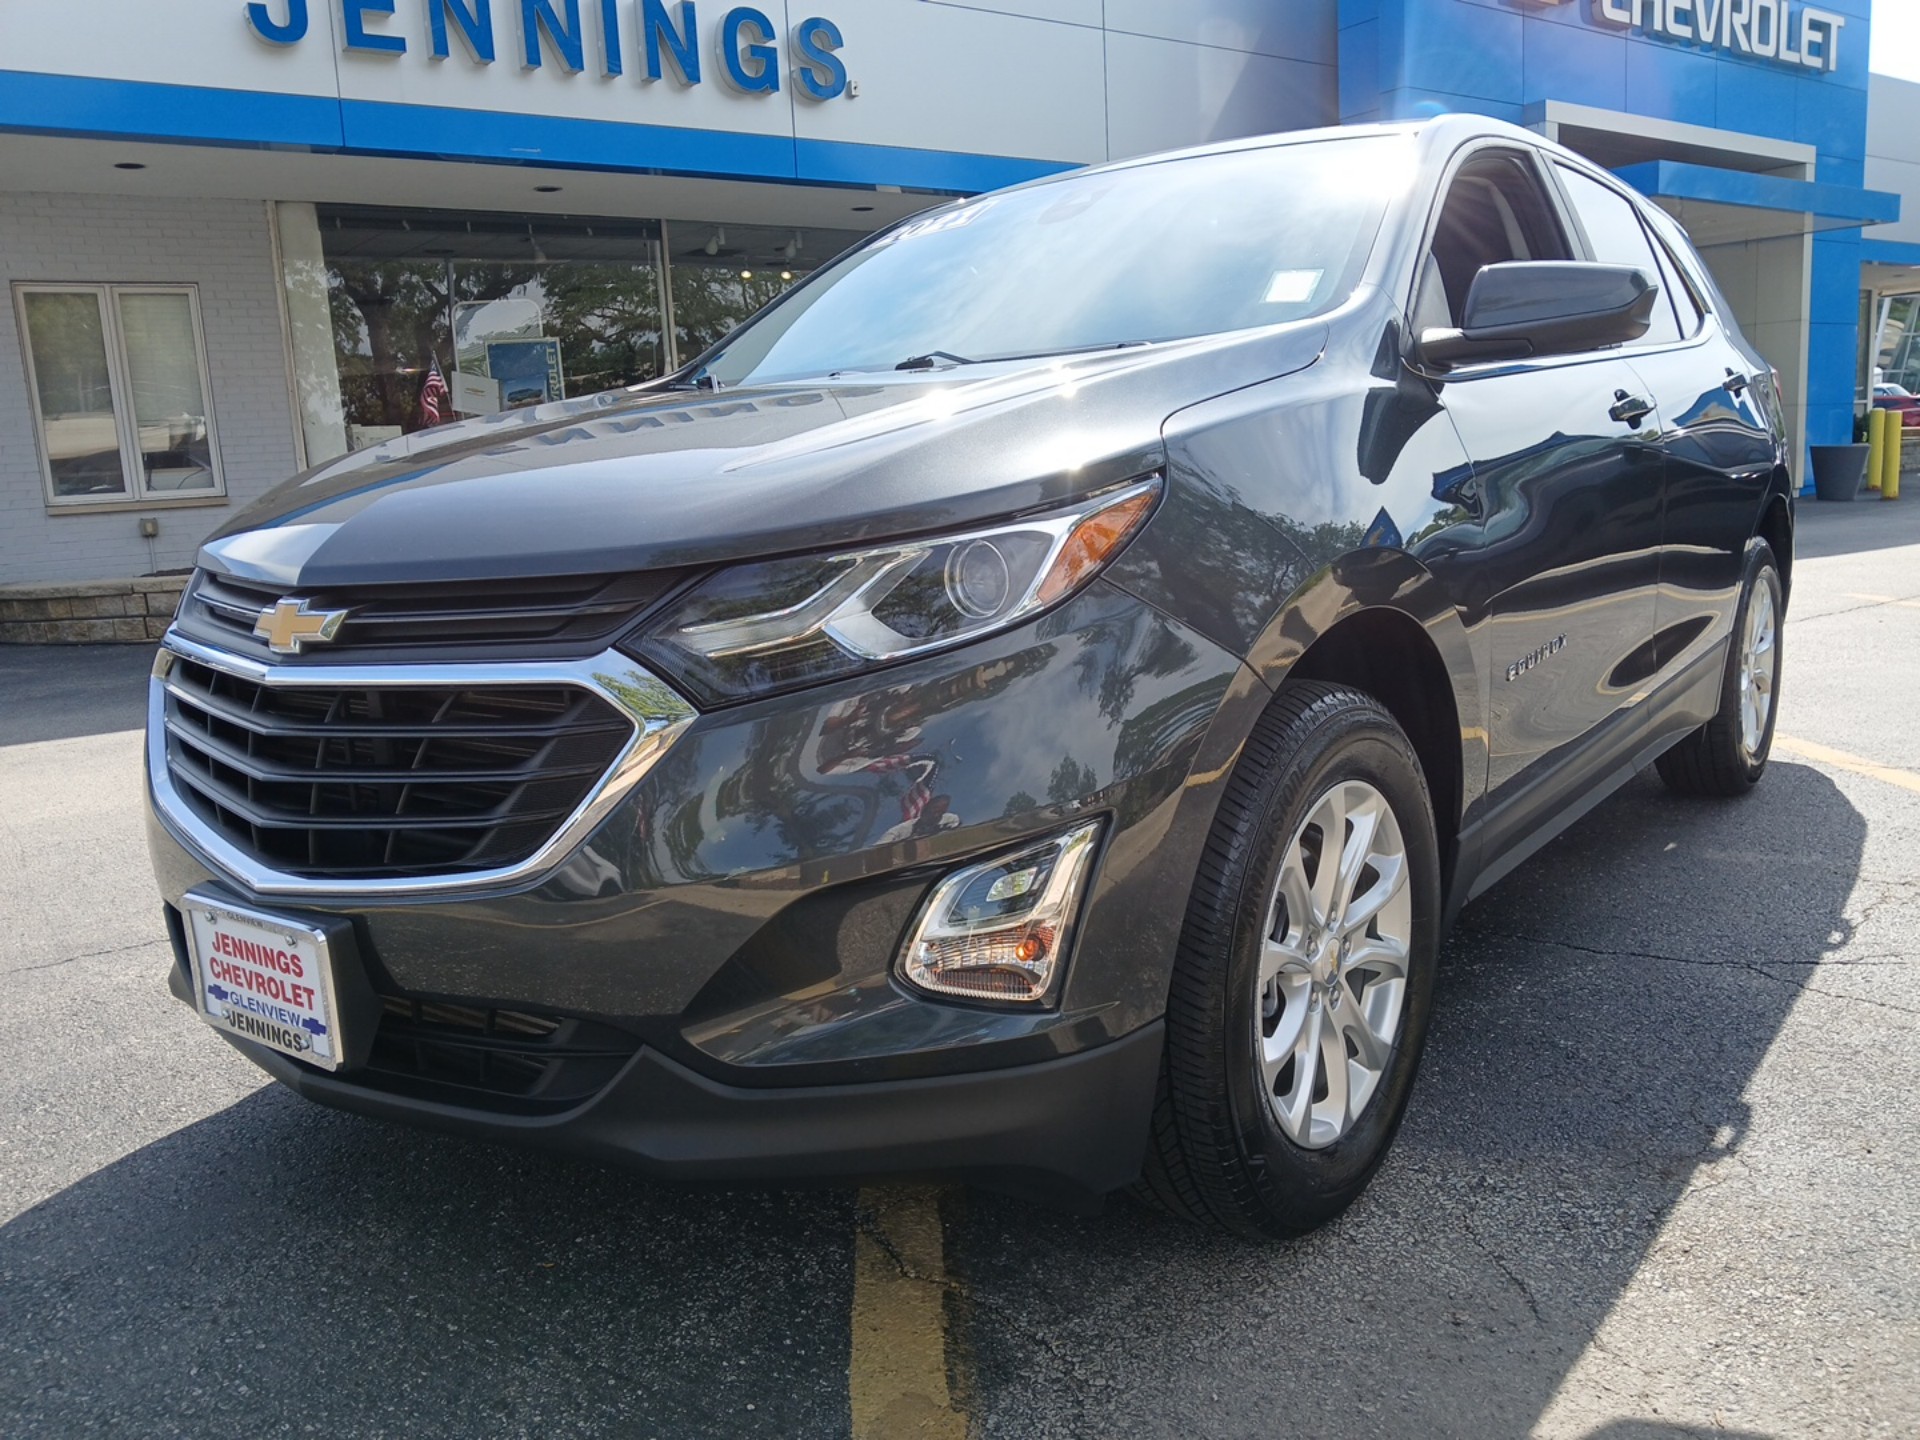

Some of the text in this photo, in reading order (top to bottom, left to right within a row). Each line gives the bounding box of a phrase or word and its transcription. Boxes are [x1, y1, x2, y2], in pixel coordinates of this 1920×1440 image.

[244, 0, 848, 100] JENNINGS
[1505, 632, 1567, 682] EQUINOX
[212, 931, 303, 978] JENNINGS
[210, 957, 314, 1011] CHEVROLET
[229, 1010, 303, 1052] JENNINGS
[230, 991, 300, 1028] GLENVIEW
